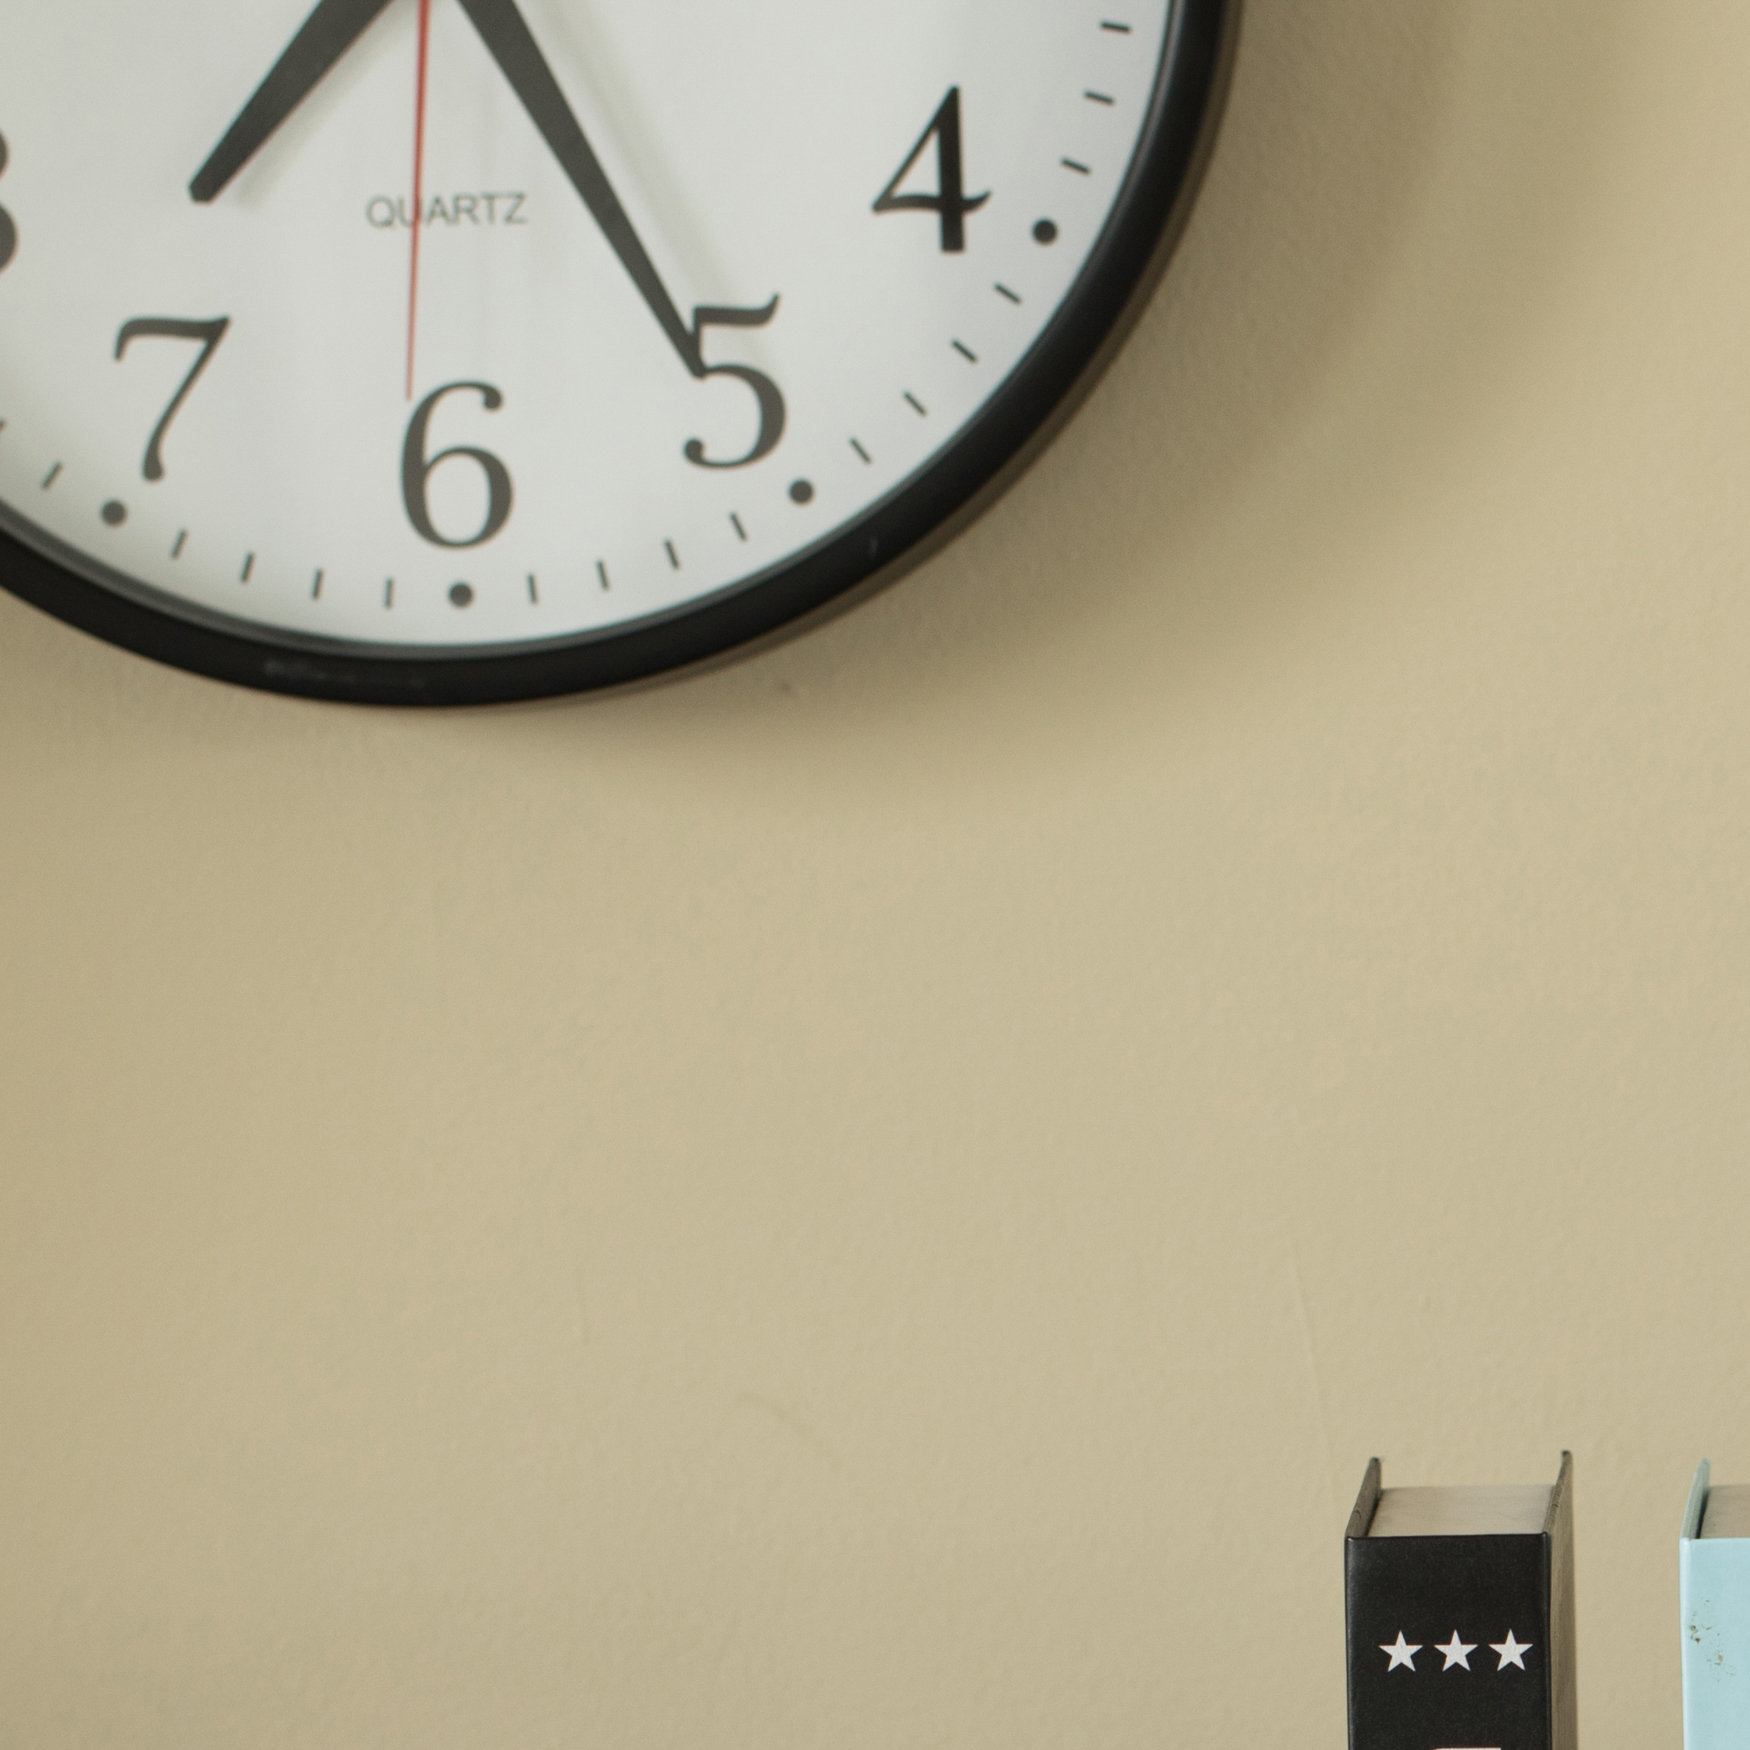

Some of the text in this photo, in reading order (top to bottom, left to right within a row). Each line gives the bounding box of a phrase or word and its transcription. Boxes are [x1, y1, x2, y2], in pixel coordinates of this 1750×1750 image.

[365, 191, 529, 227] QUARTZ
[872, 85, 991, 254] 4
[114, 315, 230, 482] 7
[401, 380, 513, 549] 6
[684, 293, 786, 469] 5
